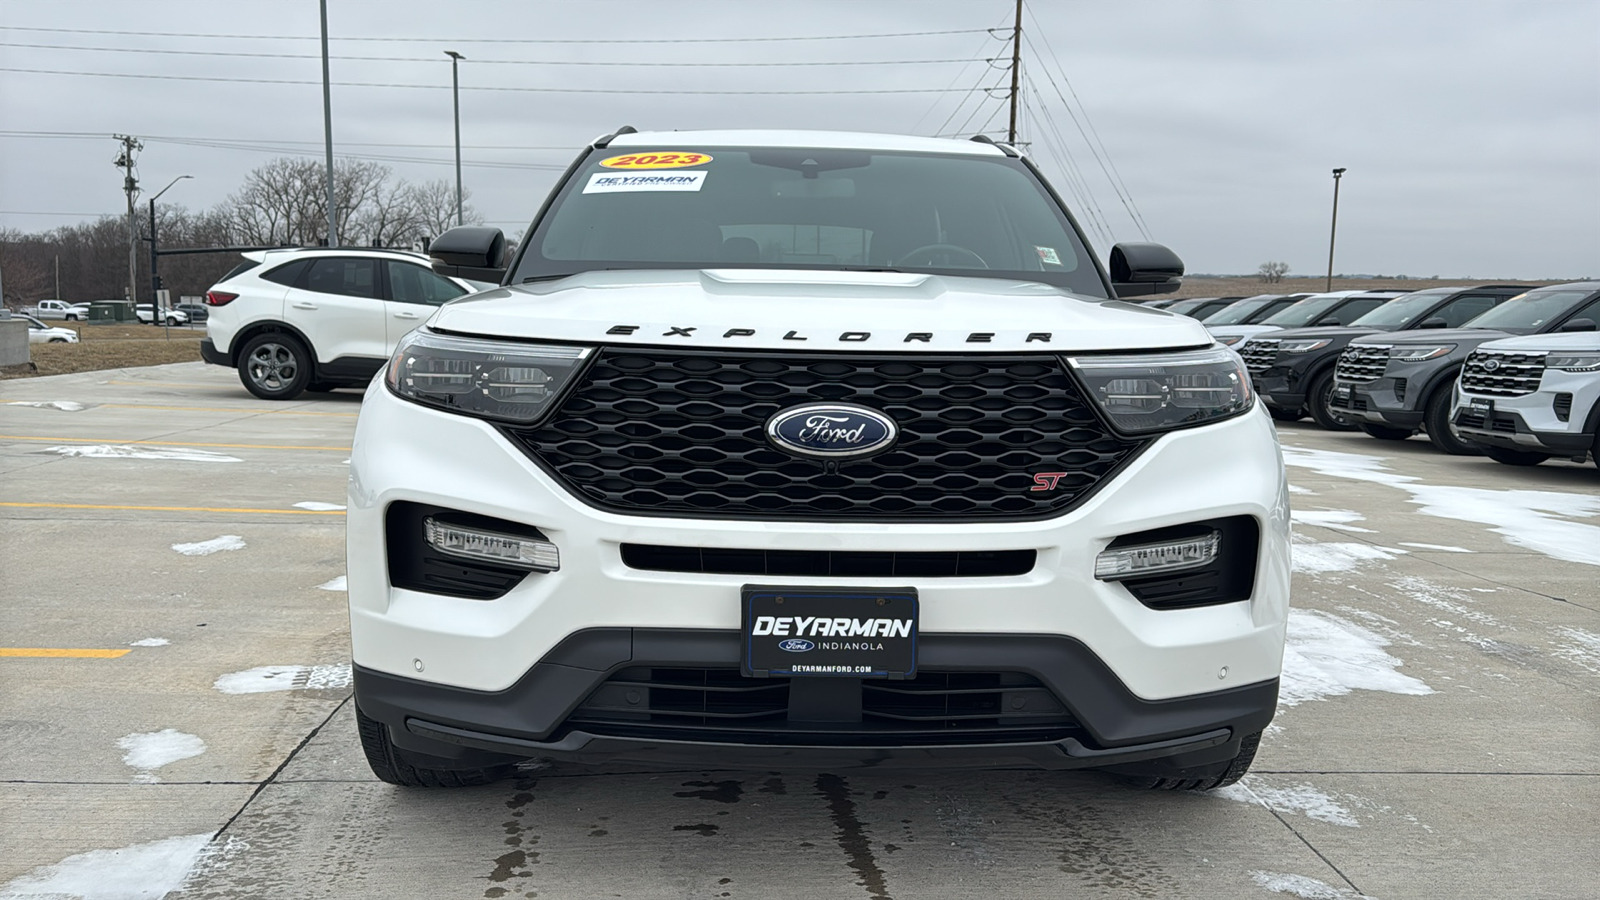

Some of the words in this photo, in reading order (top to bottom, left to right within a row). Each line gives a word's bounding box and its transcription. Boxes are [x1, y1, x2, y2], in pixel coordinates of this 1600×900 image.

[611, 155, 702, 166] 2023
[595, 176, 698, 184] DEYARMAN
[605, 325, 1053, 343] EXPLORER
[798, 415, 867, 443] Ford
[1030, 472, 1068, 491] ST
[752, 616, 913, 637] DEYARMAN
[786, 640, 808, 650] Ford
[818, 642, 884, 650] INDIANOLA
[792, 665, 872, 673] DEYARMANFORD.COM
